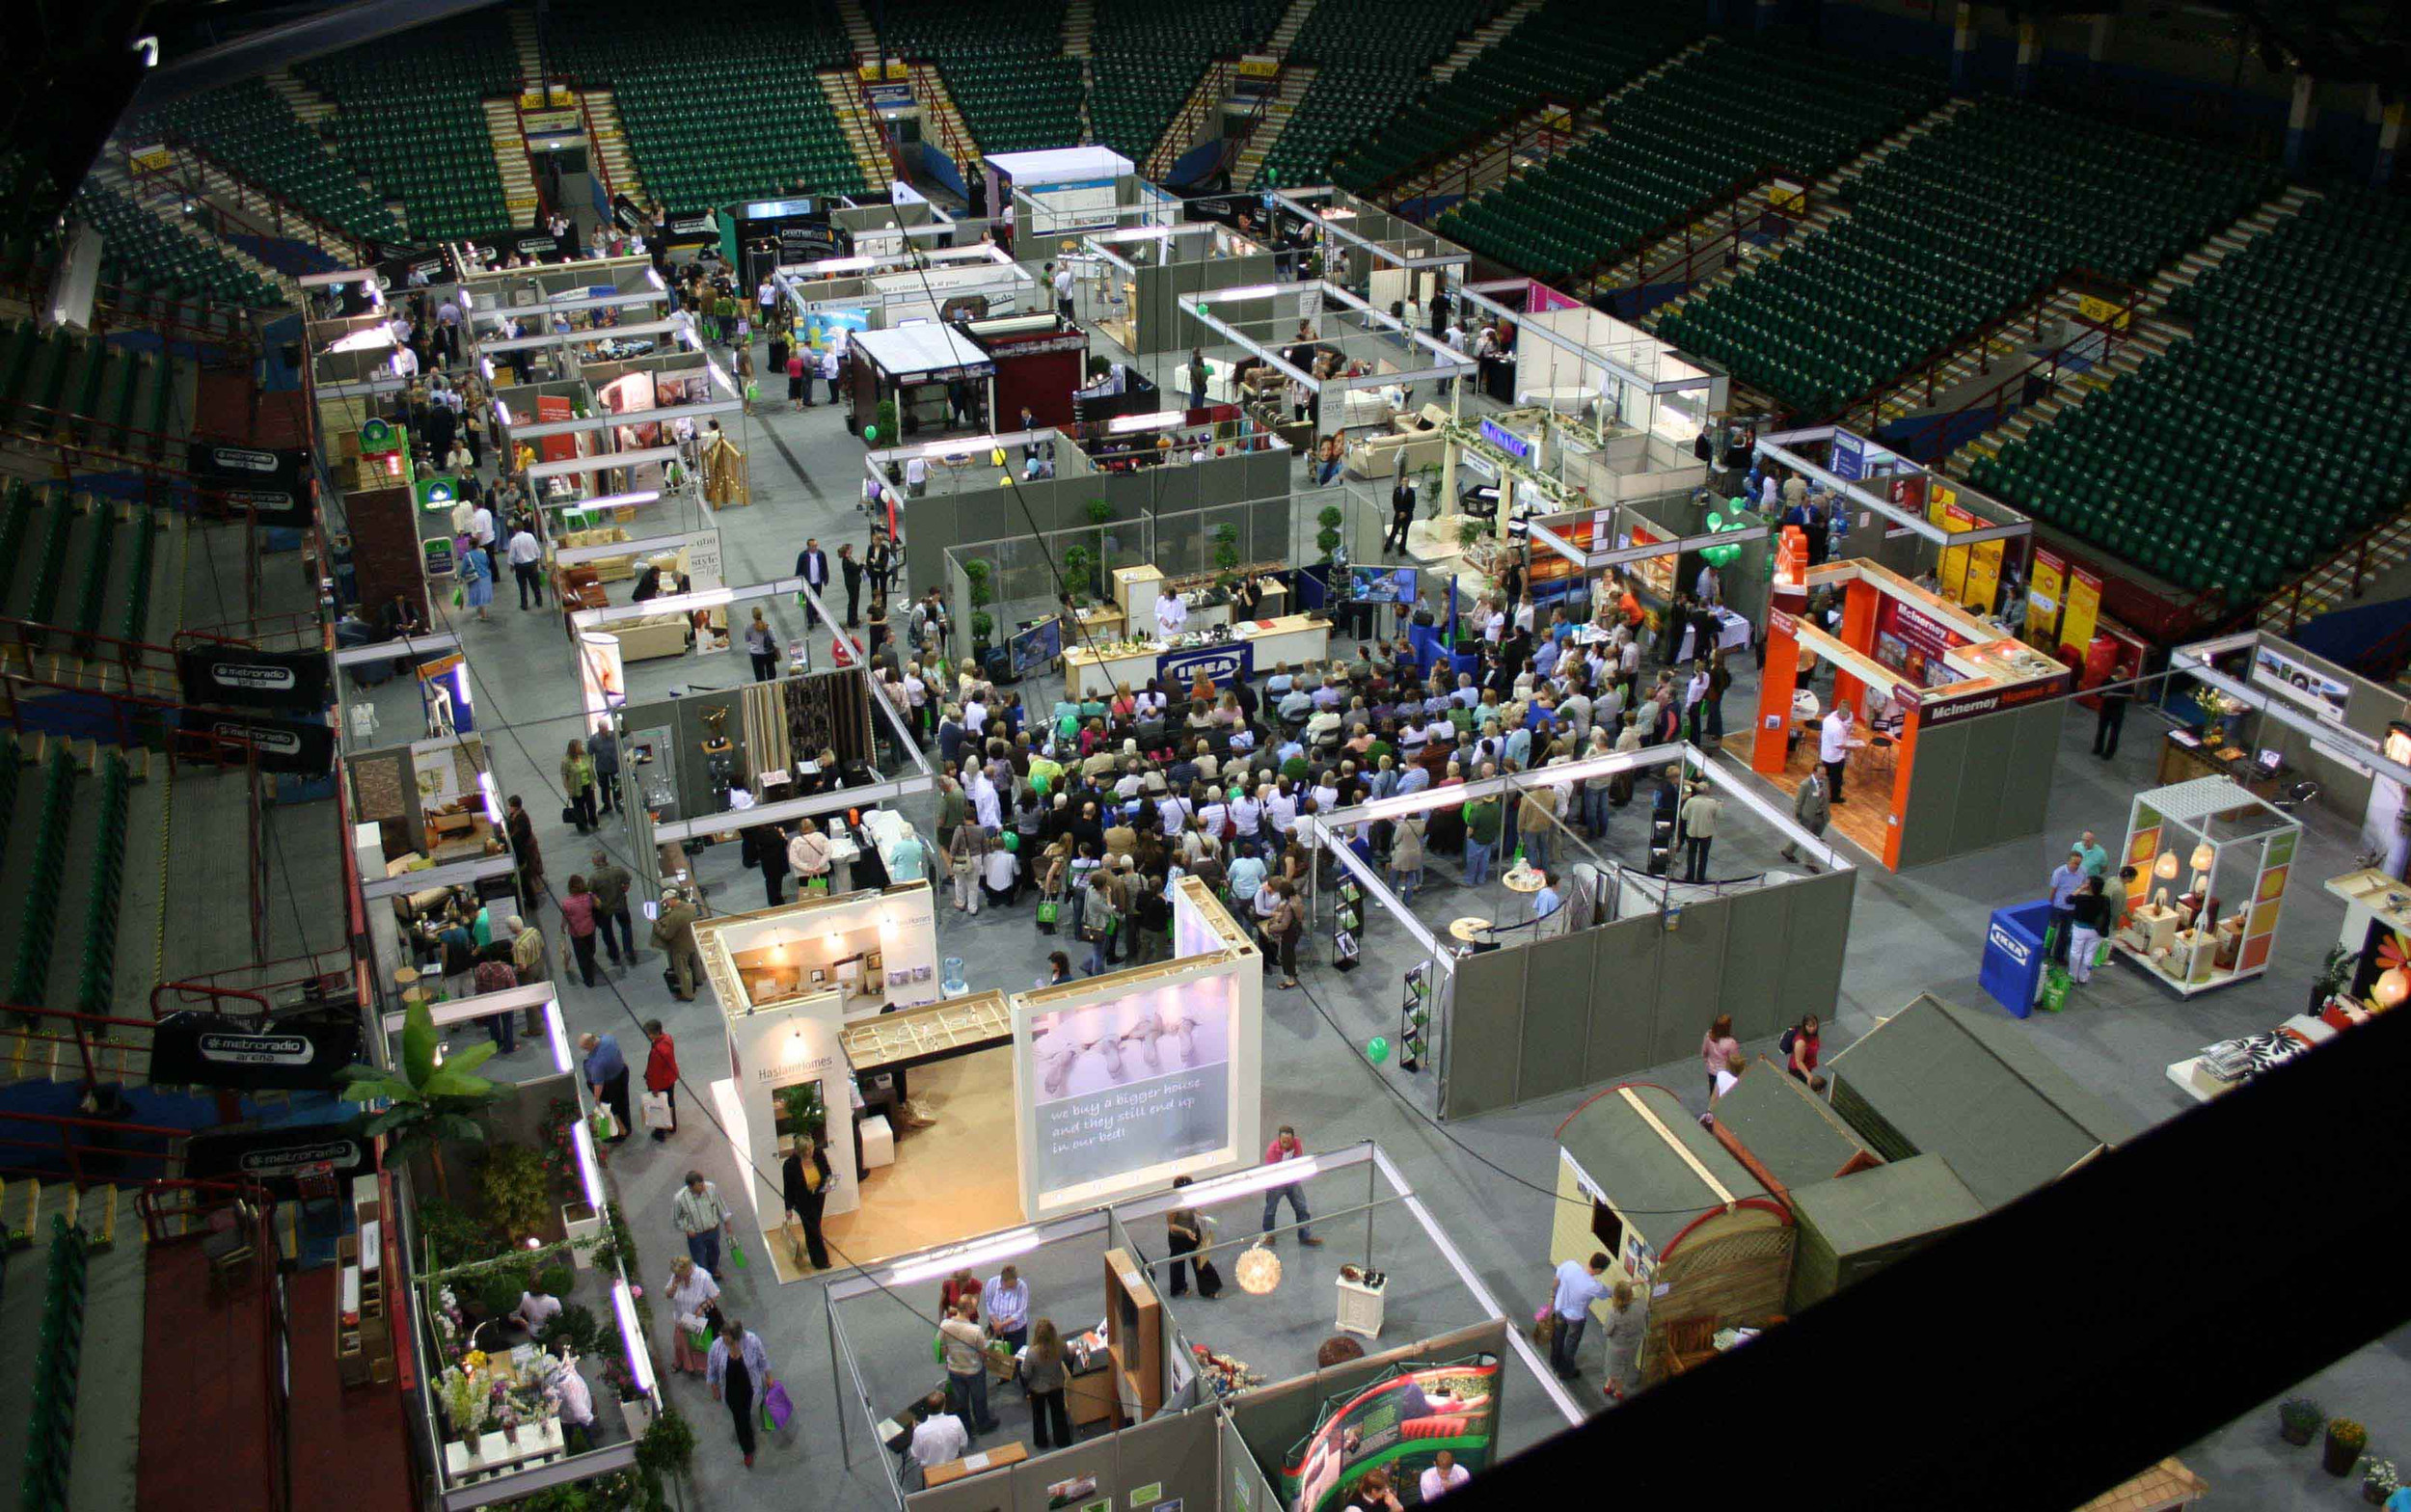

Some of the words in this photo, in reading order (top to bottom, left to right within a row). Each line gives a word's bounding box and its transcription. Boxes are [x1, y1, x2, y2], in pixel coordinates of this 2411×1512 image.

[1898, 603, 1947, 639] McInerney
[229, 668, 285, 679] metroradio
[1932, 696, 1999, 720] McInerney
[230, 728, 291, 742] metoradio
[1994, 930, 2023, 958] IKEA
[223, 1039, 301, 1052] metroradio
[236, 1053, 275, 1062] arena
[758, 1056, 833, 1081] HaslamHomes
[1050, 1111, 1070, 1120] we
[1072, 1102, 1100, 1117] buy
[1104, 1098, 1112, 1109] a
[1116, 1086, 1161, 1105] bigger
[1163, 1078, 1203, 1095] house
[1052, 1121, 1080, 1138] and
[1084, 1115, 1114, 1130] they
[1117, 1106, 1147, 1122] still
[1150, 1099, 1176, 1114] end
[1178, 1096, 1196, 1109] up
[263, 1144, 346, 1165] metroradio
[1052, 1142, 1070, 1155] in
[1072, 1136, 1096, 1150] our
